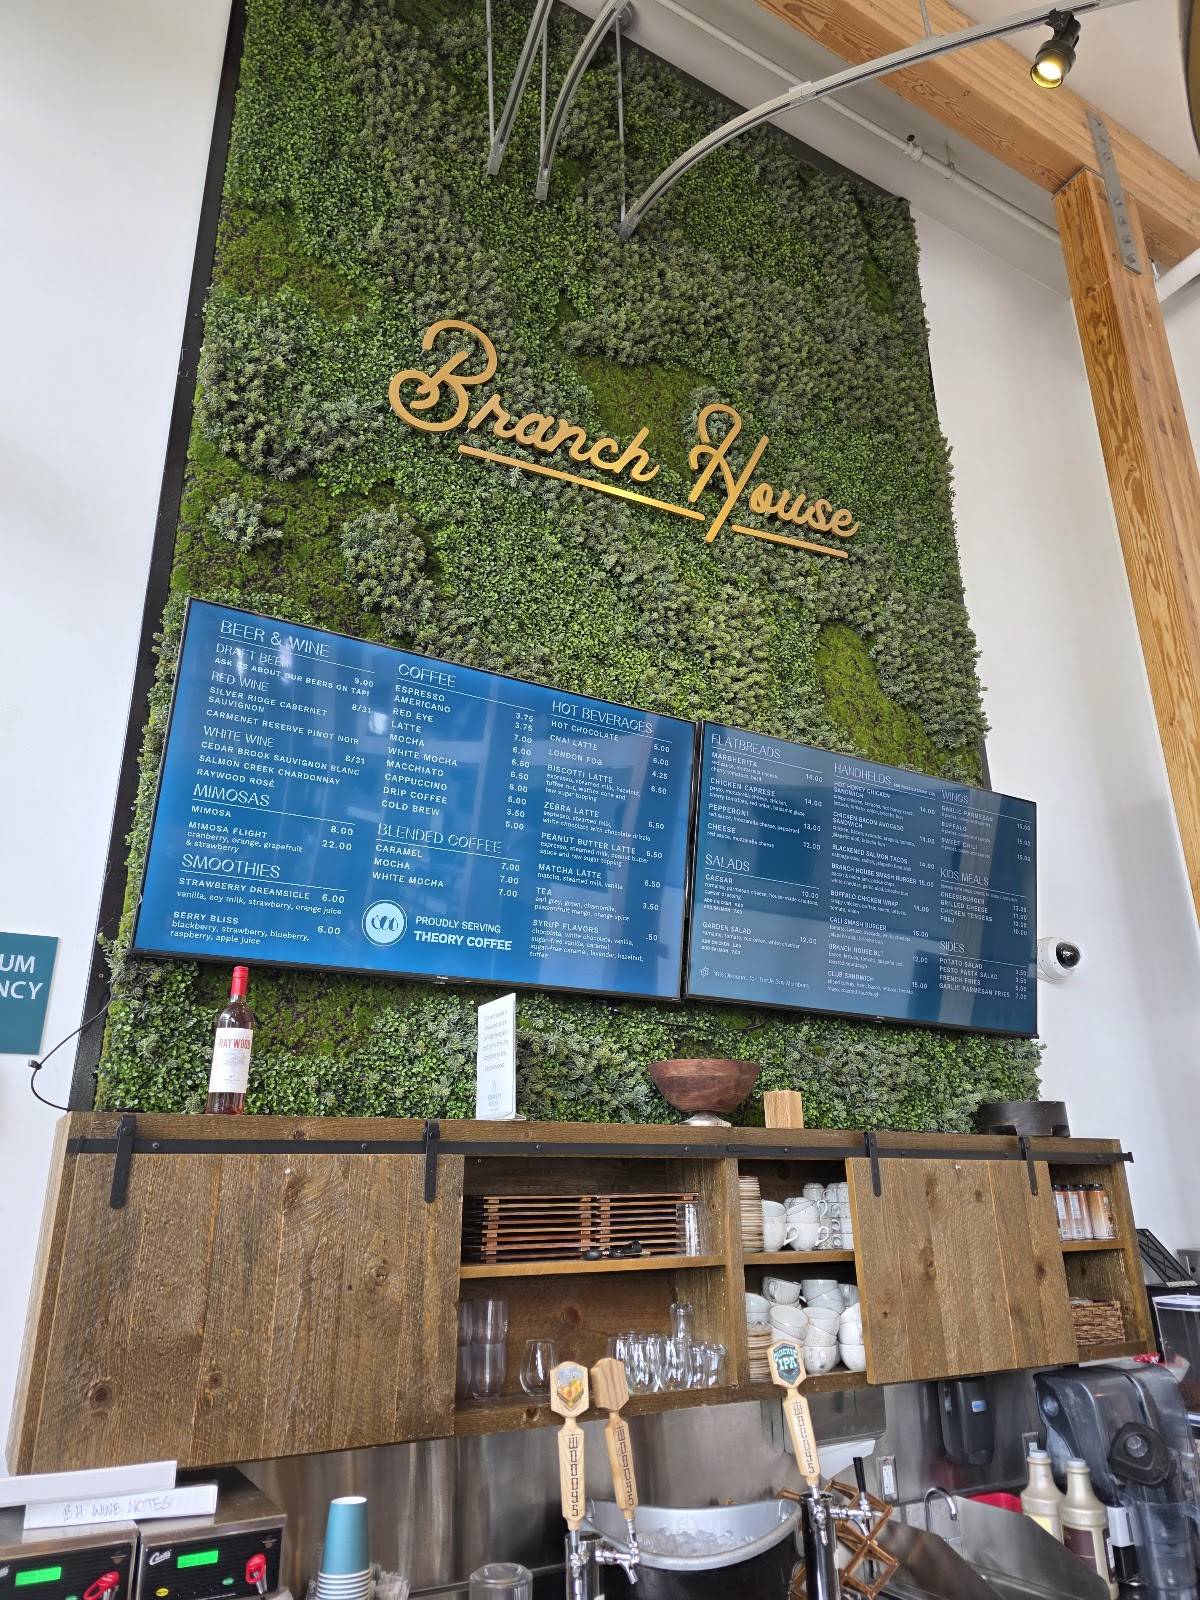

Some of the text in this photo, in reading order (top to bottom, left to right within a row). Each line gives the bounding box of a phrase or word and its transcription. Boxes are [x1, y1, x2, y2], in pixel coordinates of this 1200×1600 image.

[388, 319, 859, 543] Branch House
[220, 620, 329, 658] BEER & WINE
[216, 643, 289, 668] DRAFT BEER
[212, 670, 270, 692] RED WINE
[215, 658, 347, 692] ASK ABOUT OUR BEERS ON
[354, 678, 374, 688] 9.00
[399, 664, 456, 688] COFFEE
[395, 685, 445, 701] ESPRESSO
[209, 696, 264, 713] SAUVIGNON
[210, 687, 327, 716] SILVER RIDGE CABERNET
[352, 704, 371, 714] 8/31
[394, 695, 450, 713] AMERICANO
[393, 708, 433, 722] RED EYE
[516, 713, 533, 722] 3.75
[552, 701, 652, 734] HOT BEVERAGES
[207, 710, 359, 745] CARMENET RESERVE PINOT NOIR
[391, 721, 422, 733] LATTE
[551, 721, 619, 741] HOT CHOCOLATE
[203, 726, 275, 747] WHITE WINE
[389, 734, 424, 747] MOCHA
[514, 734, 532, 743] 7.00
[550, 735, 598, 750] CHAI LATTE
[712, 734, 780, 758] FLATBREADS
[202, 741, 360, 776] CEDAR BROOK SAUVIGNON BLANC
[388, 747, 457, 766] WHITE MOCHA
[549, 749, 602, 765] LONDON FOG
[199, 755, 340, 785] SALMON CREEK CHARDONNAY
[386, 760, 444, 776] MACCHIATO
[548, 765, 612, 783] BISCOTTI LATTE
[834, 763, 892, 785] HANDHELDS
[197, 768, 275, 787] RAYWOOD ROSÉ
[384, 774, 447, 790] CAPPUCCINO
[193, 784, 270, 806] MIMOSAS
[384, 787, 447, 804] DRIP COFFEE
[711, 778, 775, 797] CHICKEN CAPRESE
[942, 790, 968, 804] WINGS
[192, 806, 231, 817] MIMOSA
[382, 800, 440, 815] COLD BREW
[544, 802, 599, 817] ZEBRA LATTE
[709, 804, 749, 816] PEPPERONI
[189, 822, 268, 839] MIMOSA FLIGHT
[708, 823, 736, 833] CHEESE
[322, 840, 352, 850] 22.00
[378, 823, 501, 853] BLENDED COFFEE
[541, 832, 636, 854] PEANUT BUTTER LATTE
[194, 841, 239, 853] strawberry
[376, 845, 422, 857] CARAMEL
[182, 854, 281, 878] SMOOTHIES
[374, 858, 410, 869] MOCHA
[501, 863, 520, 871] 7.00
[538, 864, 601, 878] MATCHA LATTE
[706, 854, 750, 872] SALADS
[372, 872, 444, 887] WHITE MOCHA
[500, 876, 518, 884] 7.00
[705, 874, 732, 883] CAESAR
[940, 868, 959, 880] KIDS
[178, 878, 310, 899] STRAWBERRY DREAMSICLE
[499, 889, 517, 898] 7.00
[536, 887, 552, 895] TEA
[322, 894, 345, 903] 6.00
[174, 912, 239, 924] BERRY BLISS
[416, 916, 501, 933] PROUDLY SERVING
[533, 920, 599, 933] SYRUP FLAVORS
[703, 922, 751, 934] GARDEN SALAD
[414, 931, 512, 950] THEORY COFFEE
[940, 941, 964, 953] SIDES
[779, 1358, 797, 1370] IPA
[92, 1503, 121, 1517] WINE
[128, 1497, 171, 1512] NOTES
